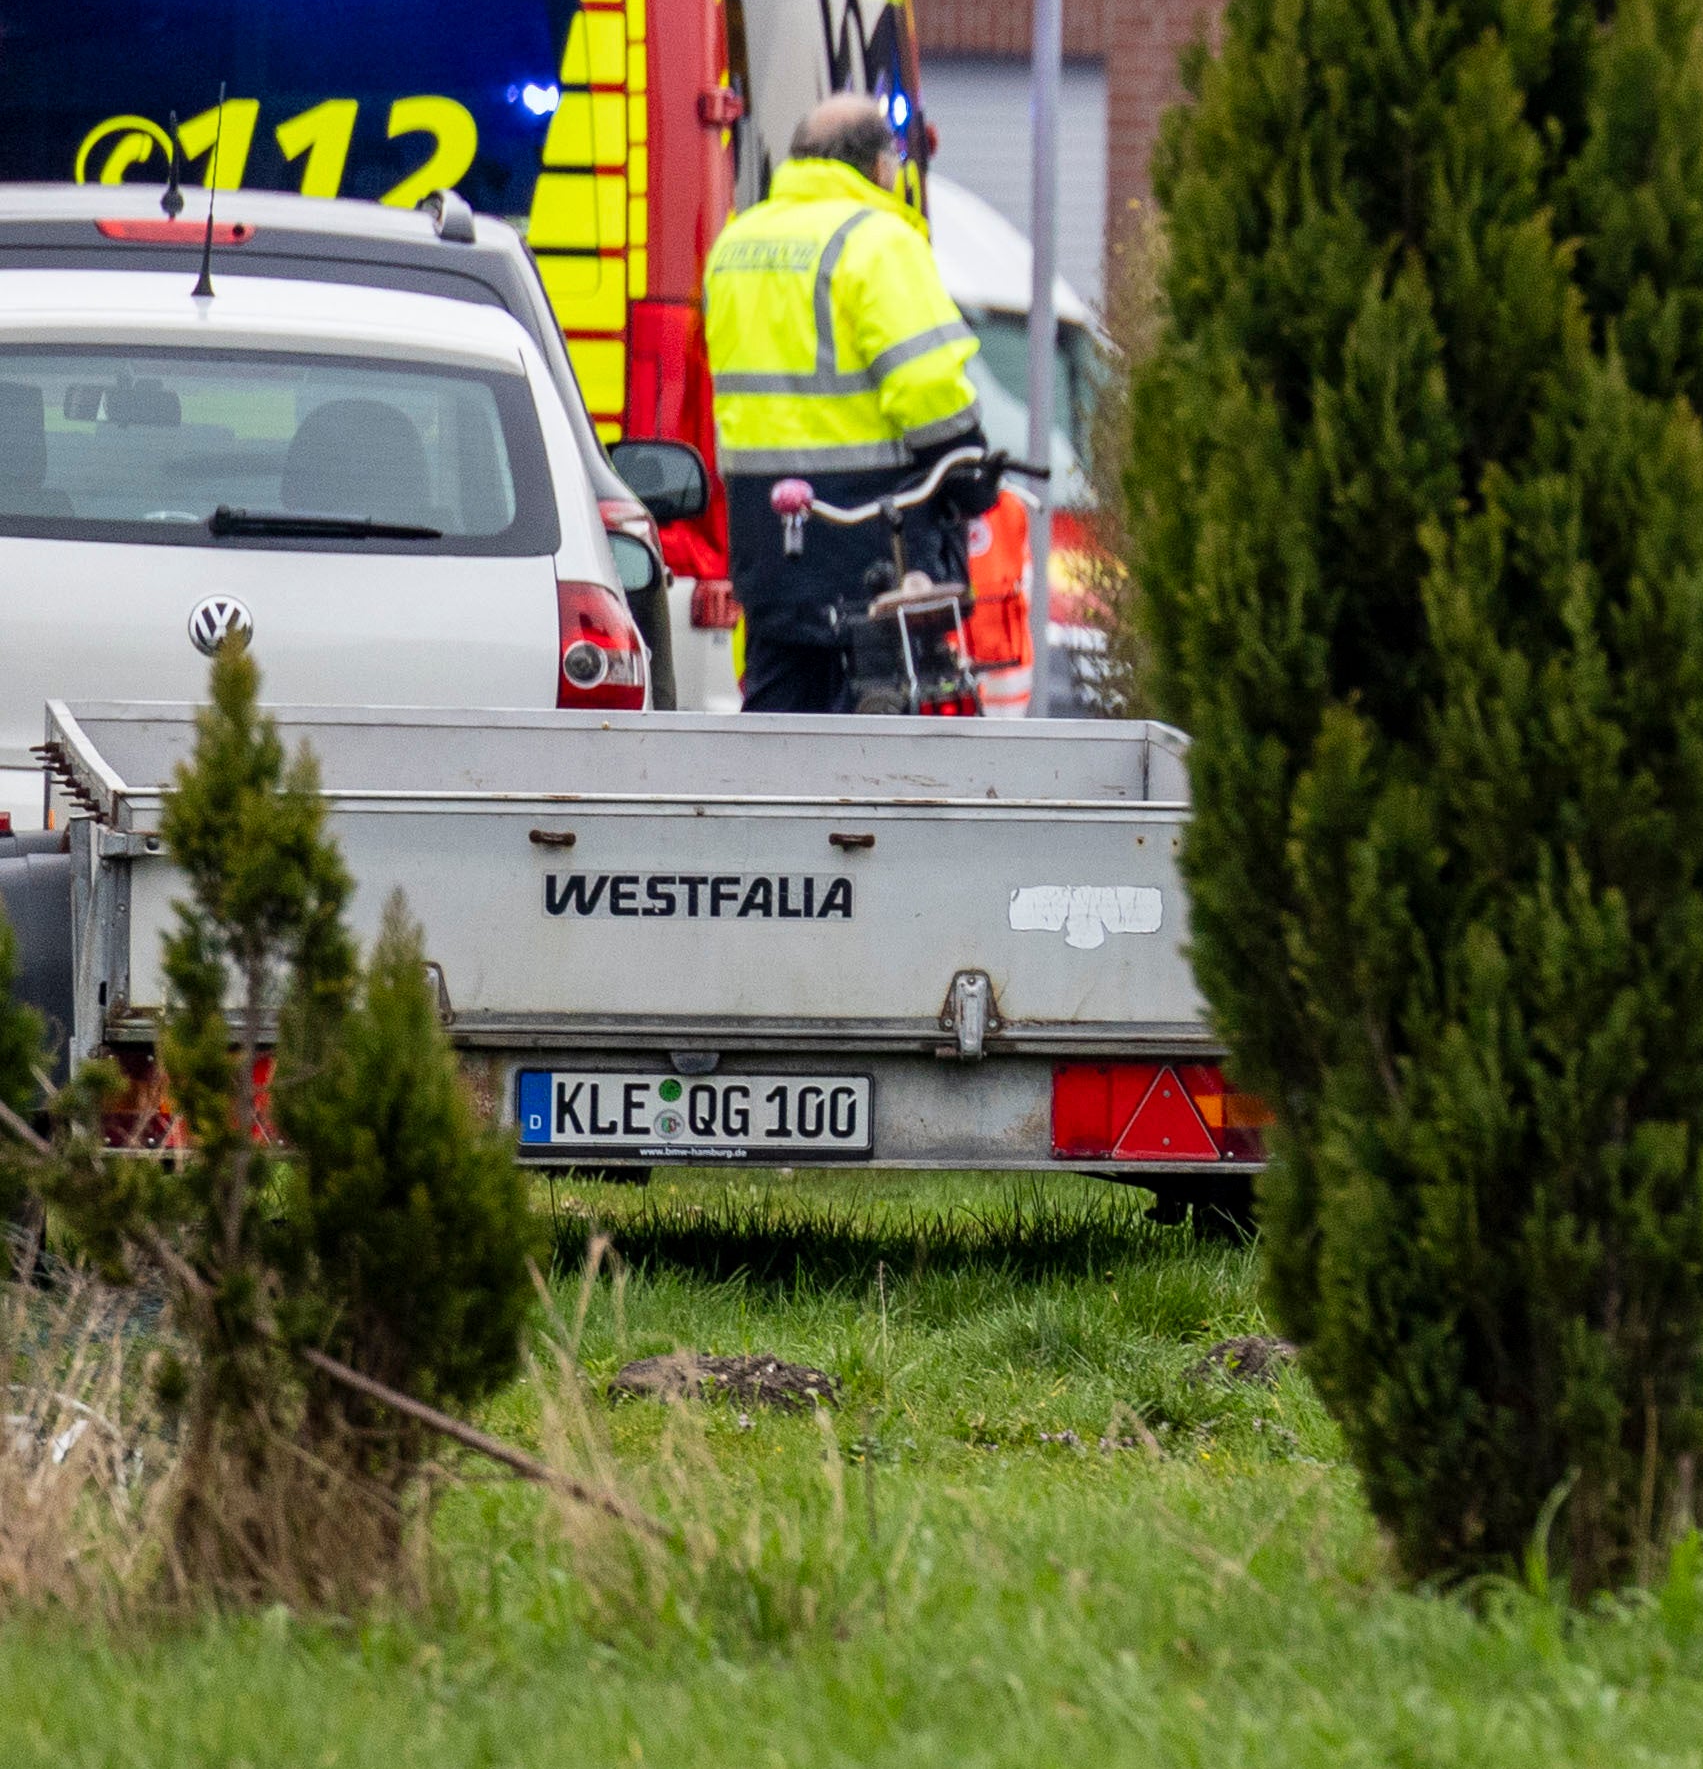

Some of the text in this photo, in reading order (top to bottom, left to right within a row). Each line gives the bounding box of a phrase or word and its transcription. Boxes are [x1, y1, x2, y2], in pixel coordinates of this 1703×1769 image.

[177, 94, 478, 208] 112
[544, 874, 854, 918] WESTFALIA
[529, 1114, 542, 1130] D
[556, 1082, 857, 1139] KLE QG 100
[639, 1146, 748, 1159] www.bmw-hamburg.de
